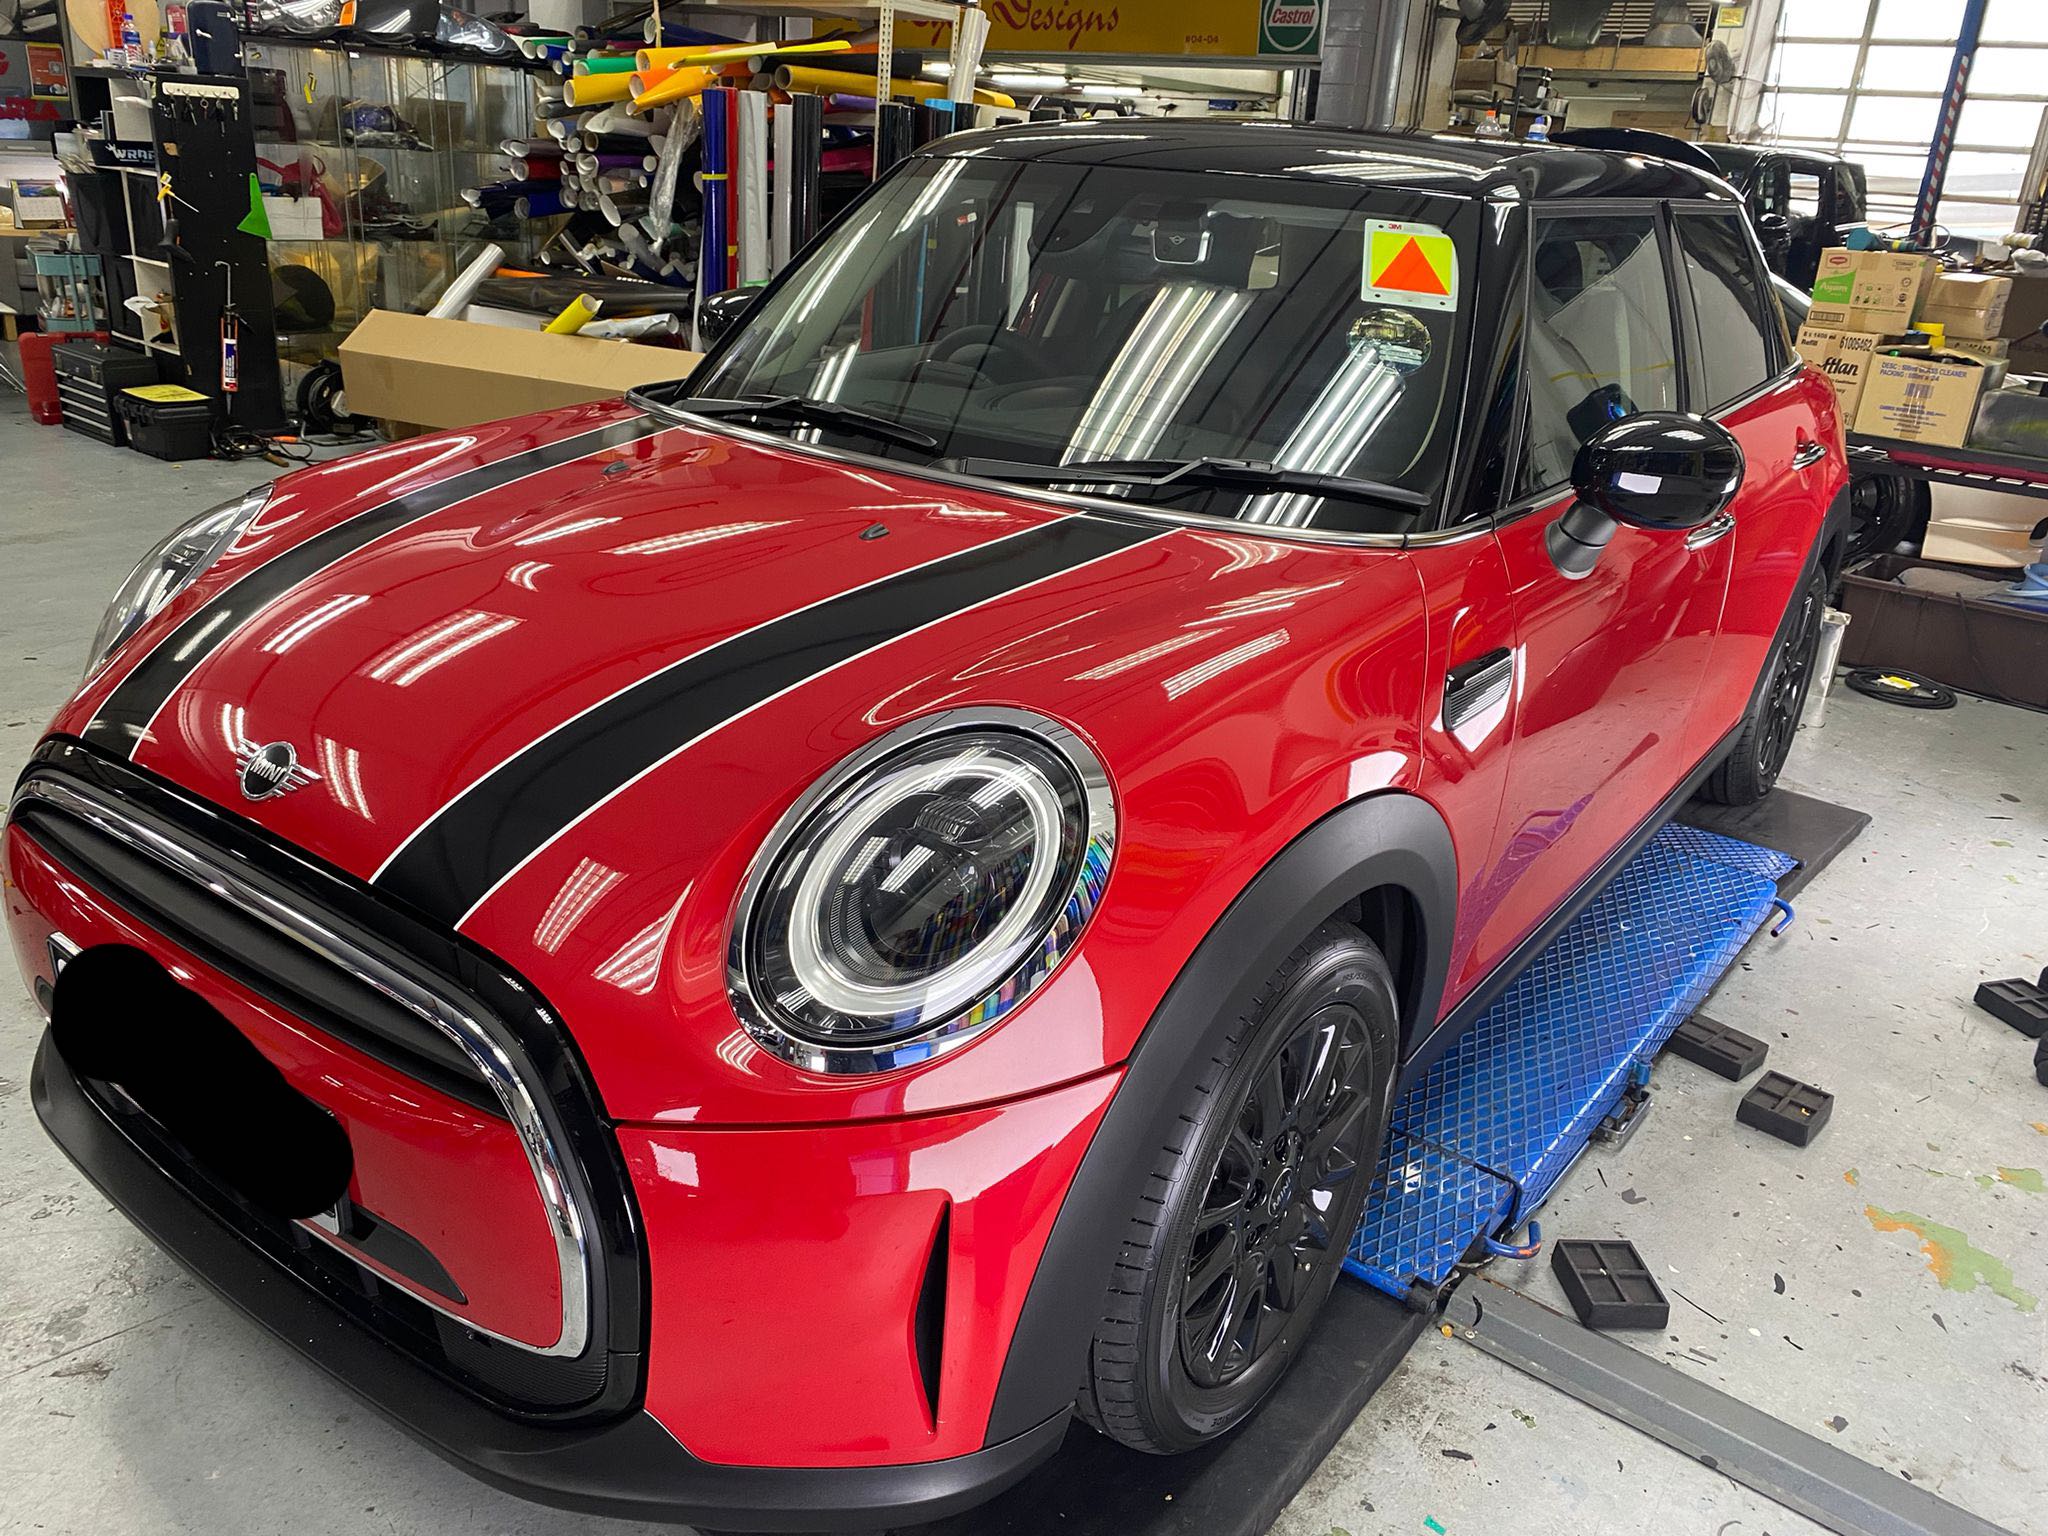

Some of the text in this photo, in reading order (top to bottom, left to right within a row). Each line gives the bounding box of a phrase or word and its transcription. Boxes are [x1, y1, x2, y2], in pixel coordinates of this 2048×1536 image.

[992, 0, 1120, 49] Designs
[1271, 8, 1316, 24] Castrol
[1816, 357, 1859, 376] ftlan
[250, 756, 287, 783] MINI
[1273, 1175, 1291, 1210] MINI
